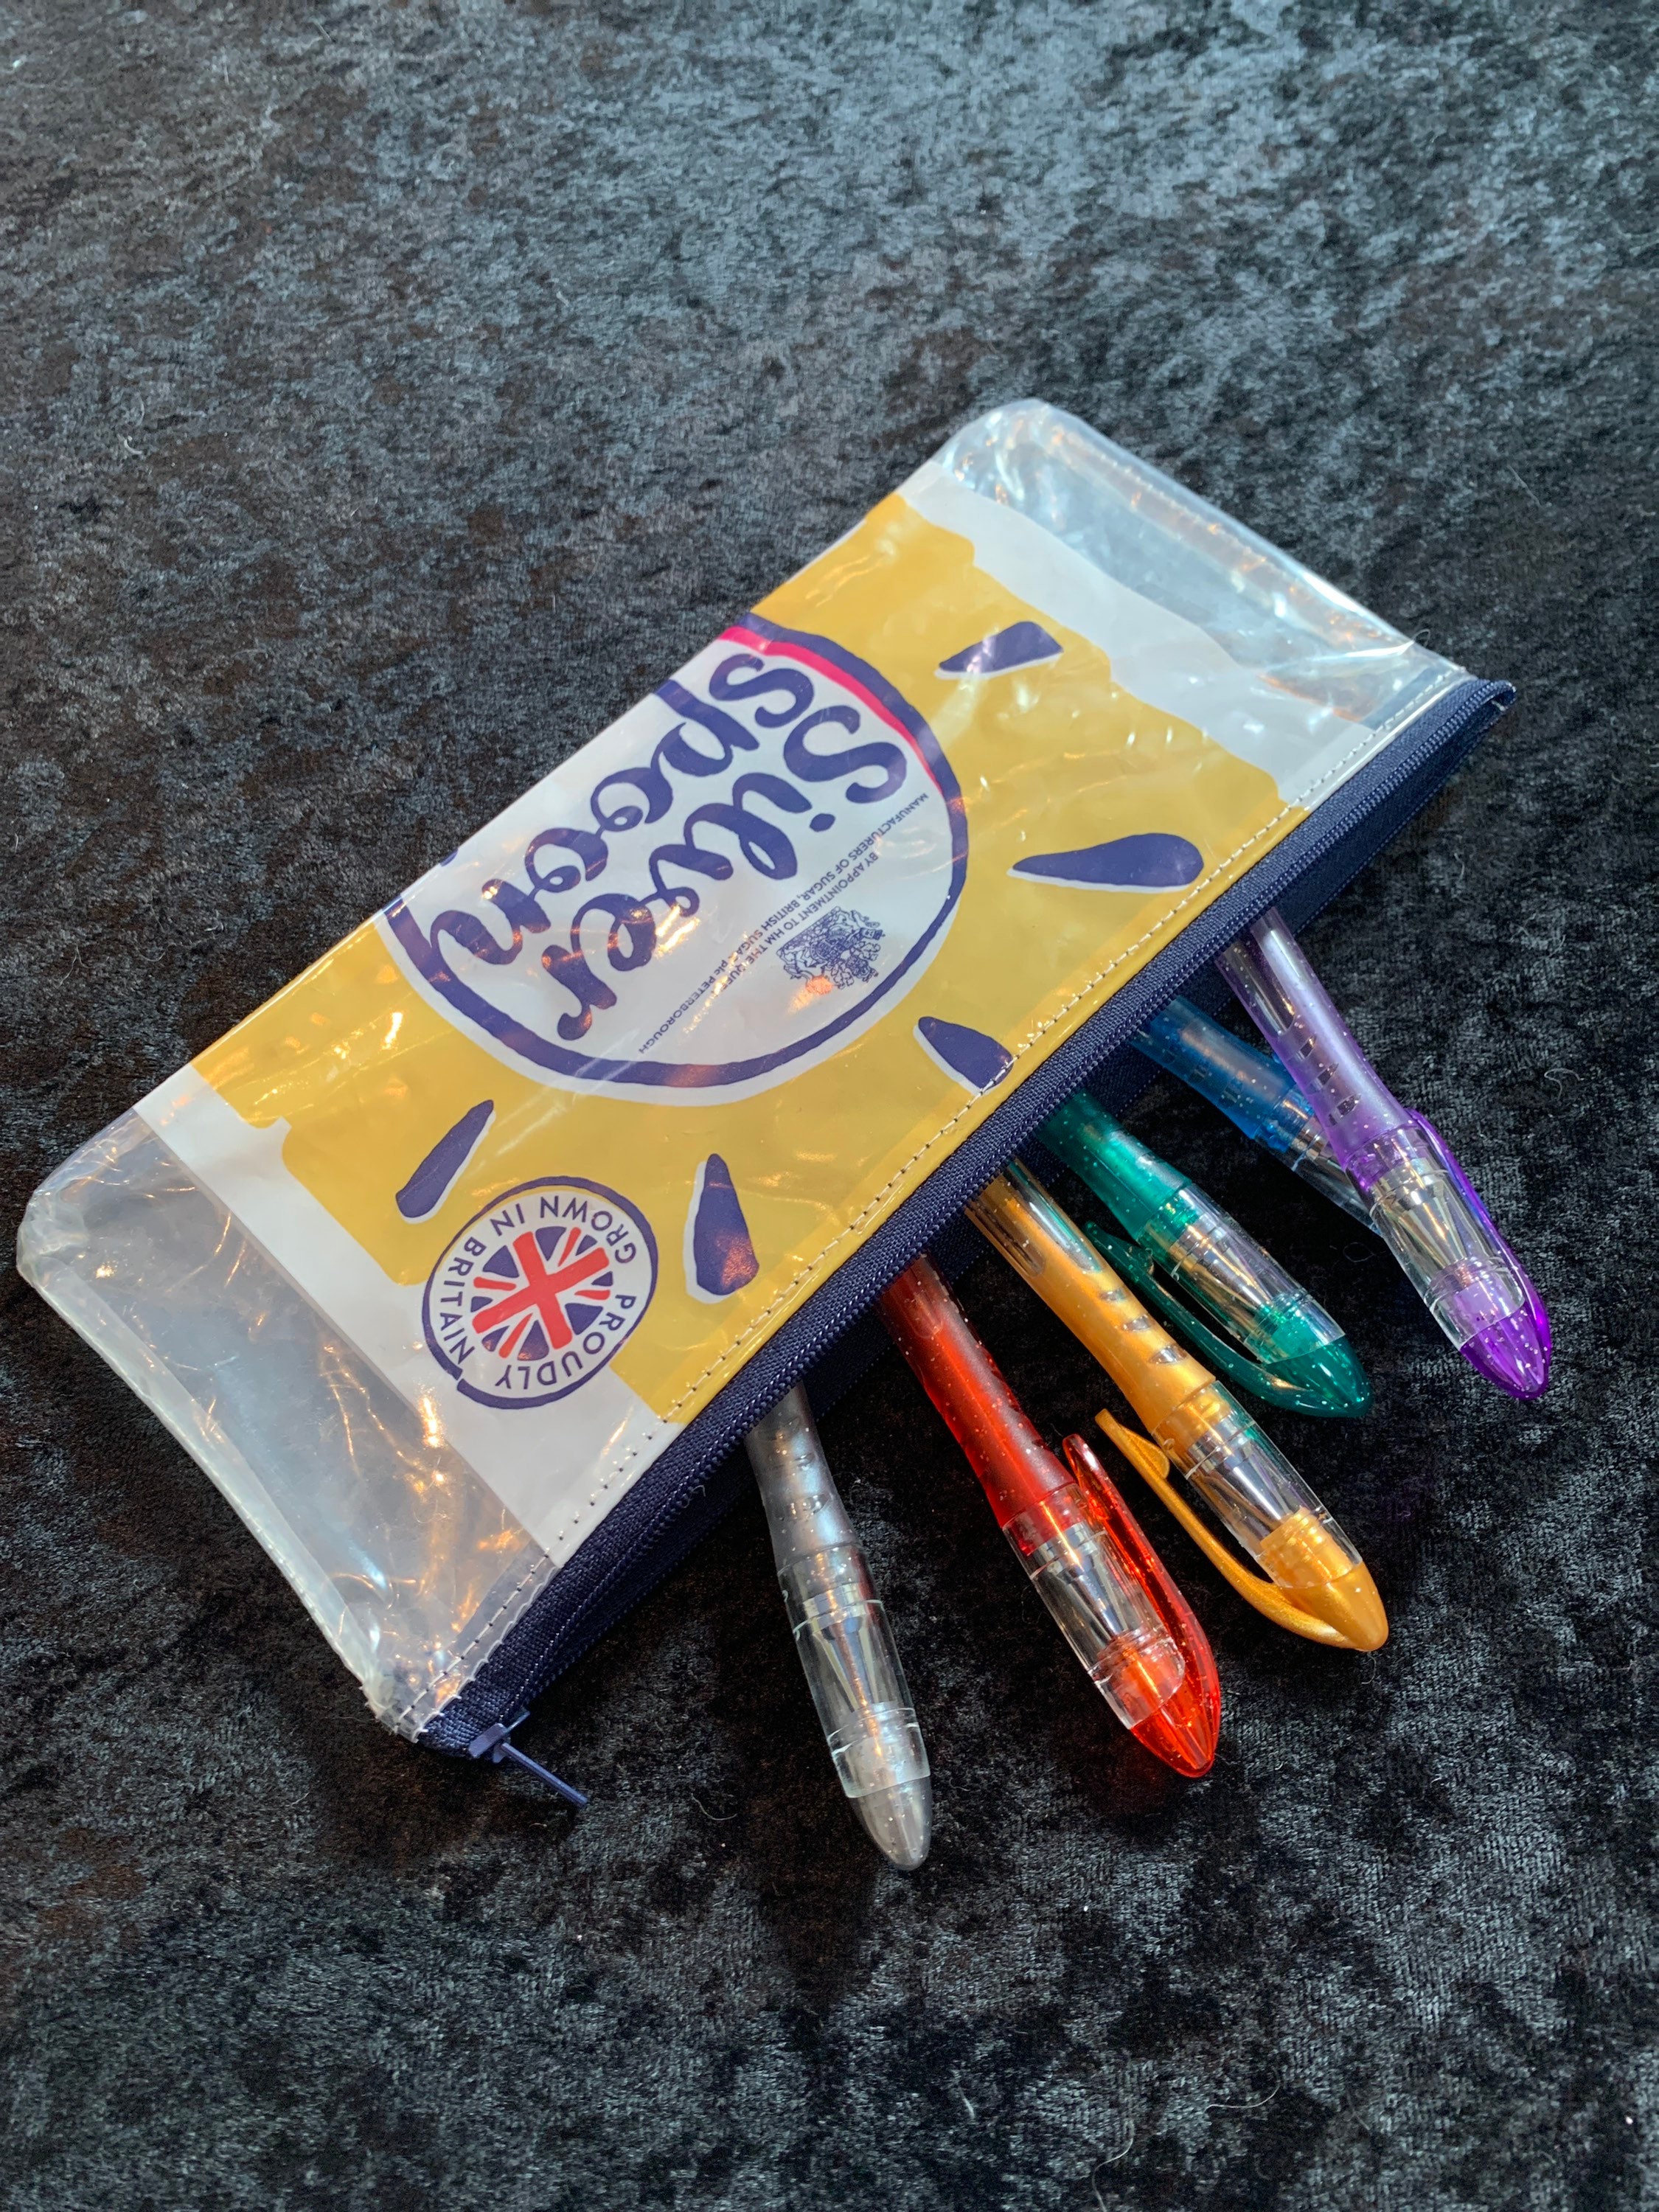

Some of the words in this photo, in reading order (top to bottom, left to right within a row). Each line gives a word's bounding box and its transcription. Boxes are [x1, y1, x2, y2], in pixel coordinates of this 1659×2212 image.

[848, 793, 929, 860] MANUFACTURERS
[557, 705, 907, 1040] Silver
[835, 858, 849, 874] OF
[864, 852, 879, 867] BY
[796, 872, 835, 901] SUGAR,
[798, 862, 865, 921] APPOINTMENT
[761, 900, 800, 931] BRITISH
[784, 919, 799, 931] TO
[765, 928, 785, 945] HM
[713, 959, 728, 975] plc
[745, 944, 768, 964] THE
[711, 964, 746, 997] QUE
[639, 975, 716, 1054] PETERBOROUGH
[490, 1203, 525, 1237] IN
[540, 1195, 636, 1263] GROWN
[439, 1237, 487, 1365] BRITAIN
[495, 1294, 636, 1389] PROUDLY
